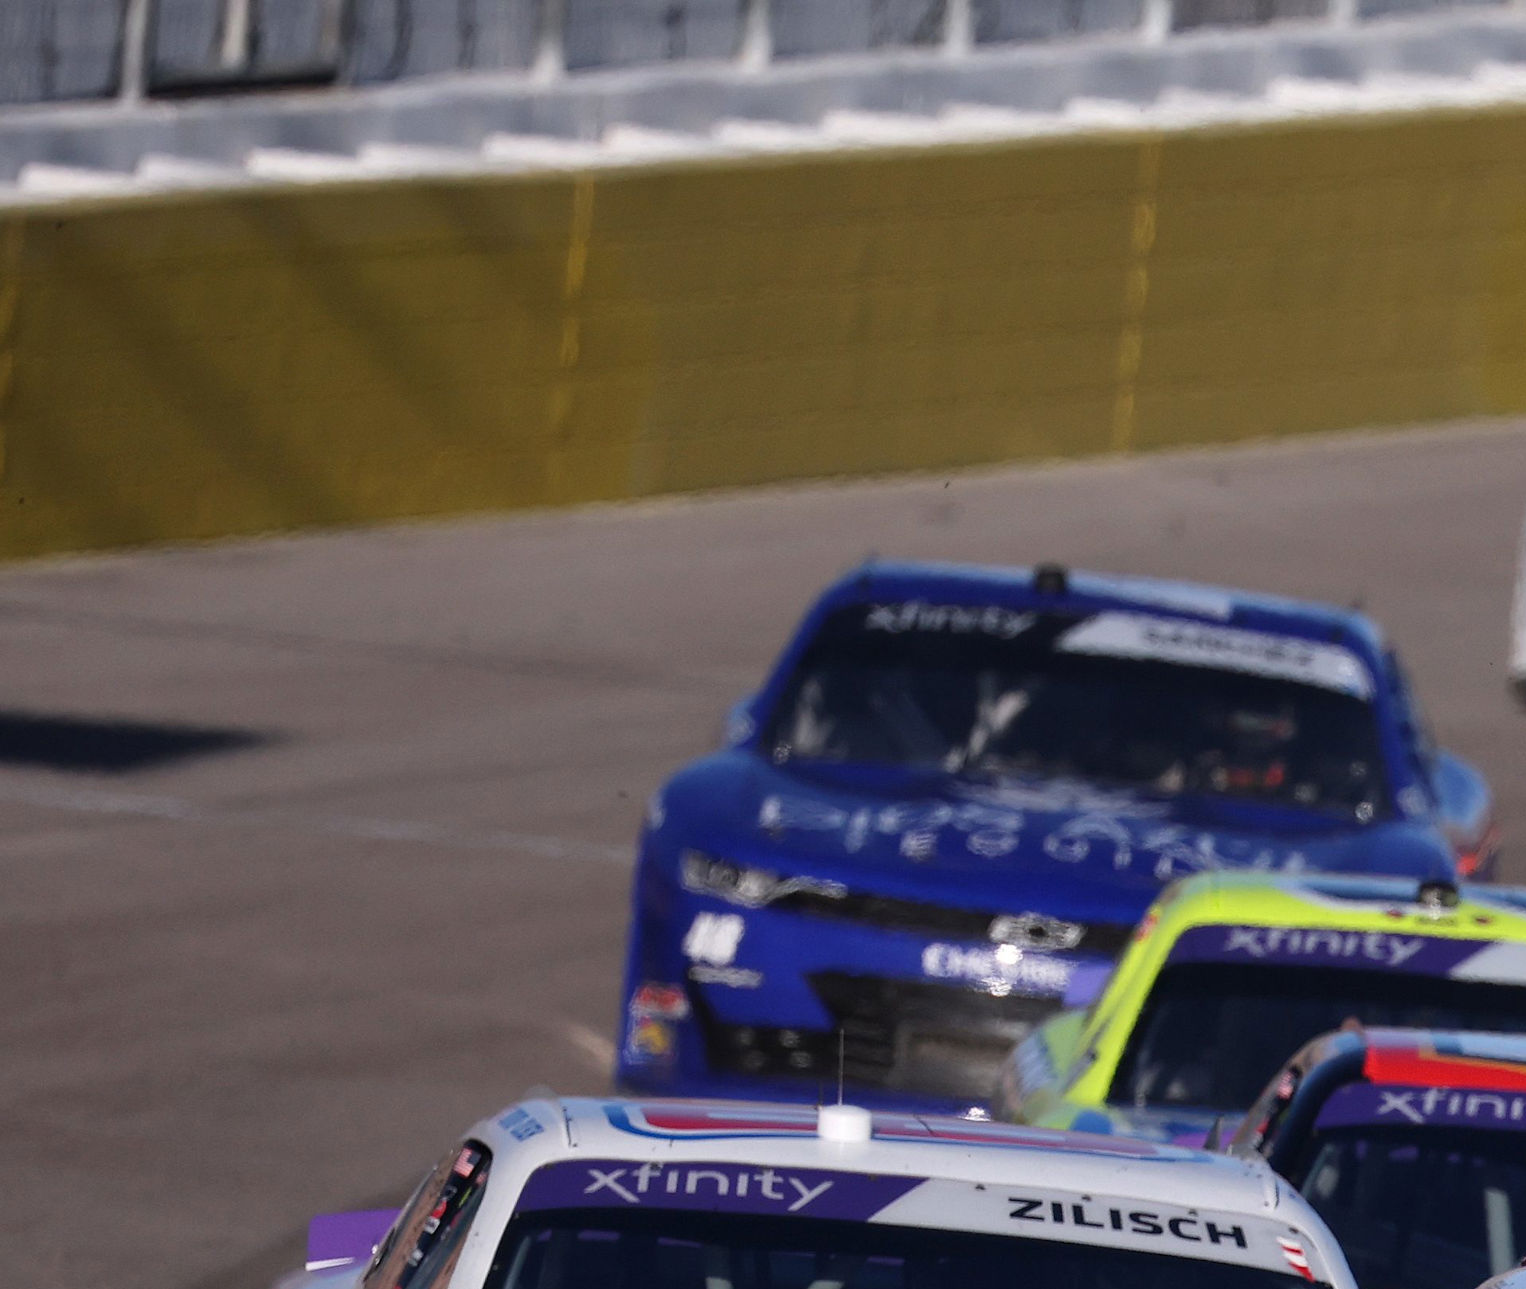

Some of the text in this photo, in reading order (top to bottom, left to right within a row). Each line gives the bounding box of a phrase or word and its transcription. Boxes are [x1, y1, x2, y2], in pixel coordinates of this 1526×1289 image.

[1223, 925, 1425, 966] xfinity
[584, 1164, 835, 1212] xfinity
[1008, 1197, 1249, 1250] ZILISCH
